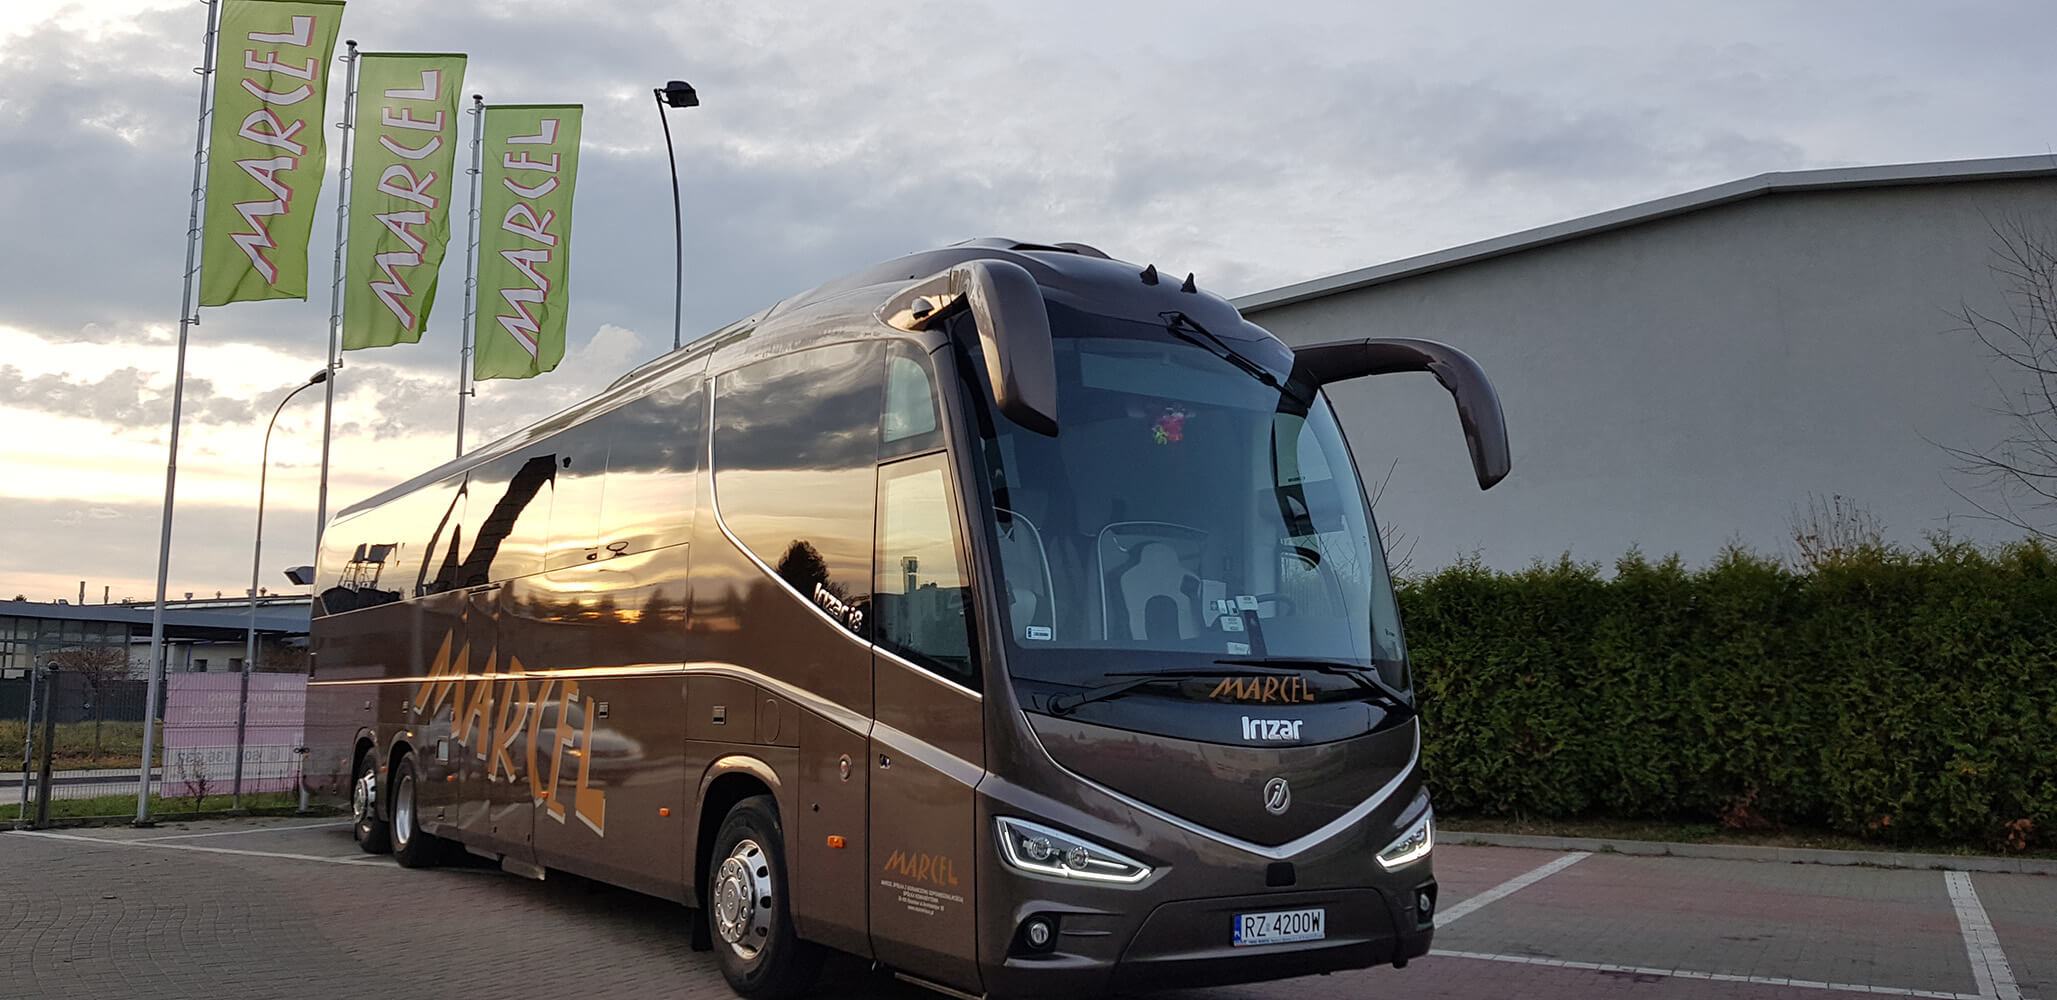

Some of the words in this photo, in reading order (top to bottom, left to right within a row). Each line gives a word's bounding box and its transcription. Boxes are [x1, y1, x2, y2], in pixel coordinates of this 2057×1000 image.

[228, 15, 318, 285] MARCEL
[368, 69, 445, 330] MARCEL
[495, 118, 561, 361] MARCEL
[814, 582, 849, 622] Irizar
[848, 606, 863, 632] i8
[1209, 676, 1315, 703] MARCEL
[413, 628, 606, 838] MARCEL
[1241, 716, 1303, 740] Irizar
[884, 849, 958, 886] MARCEL
[1245, 916, 1266, 938] RZ
[1273, 912, 1320, 935] 4200W
